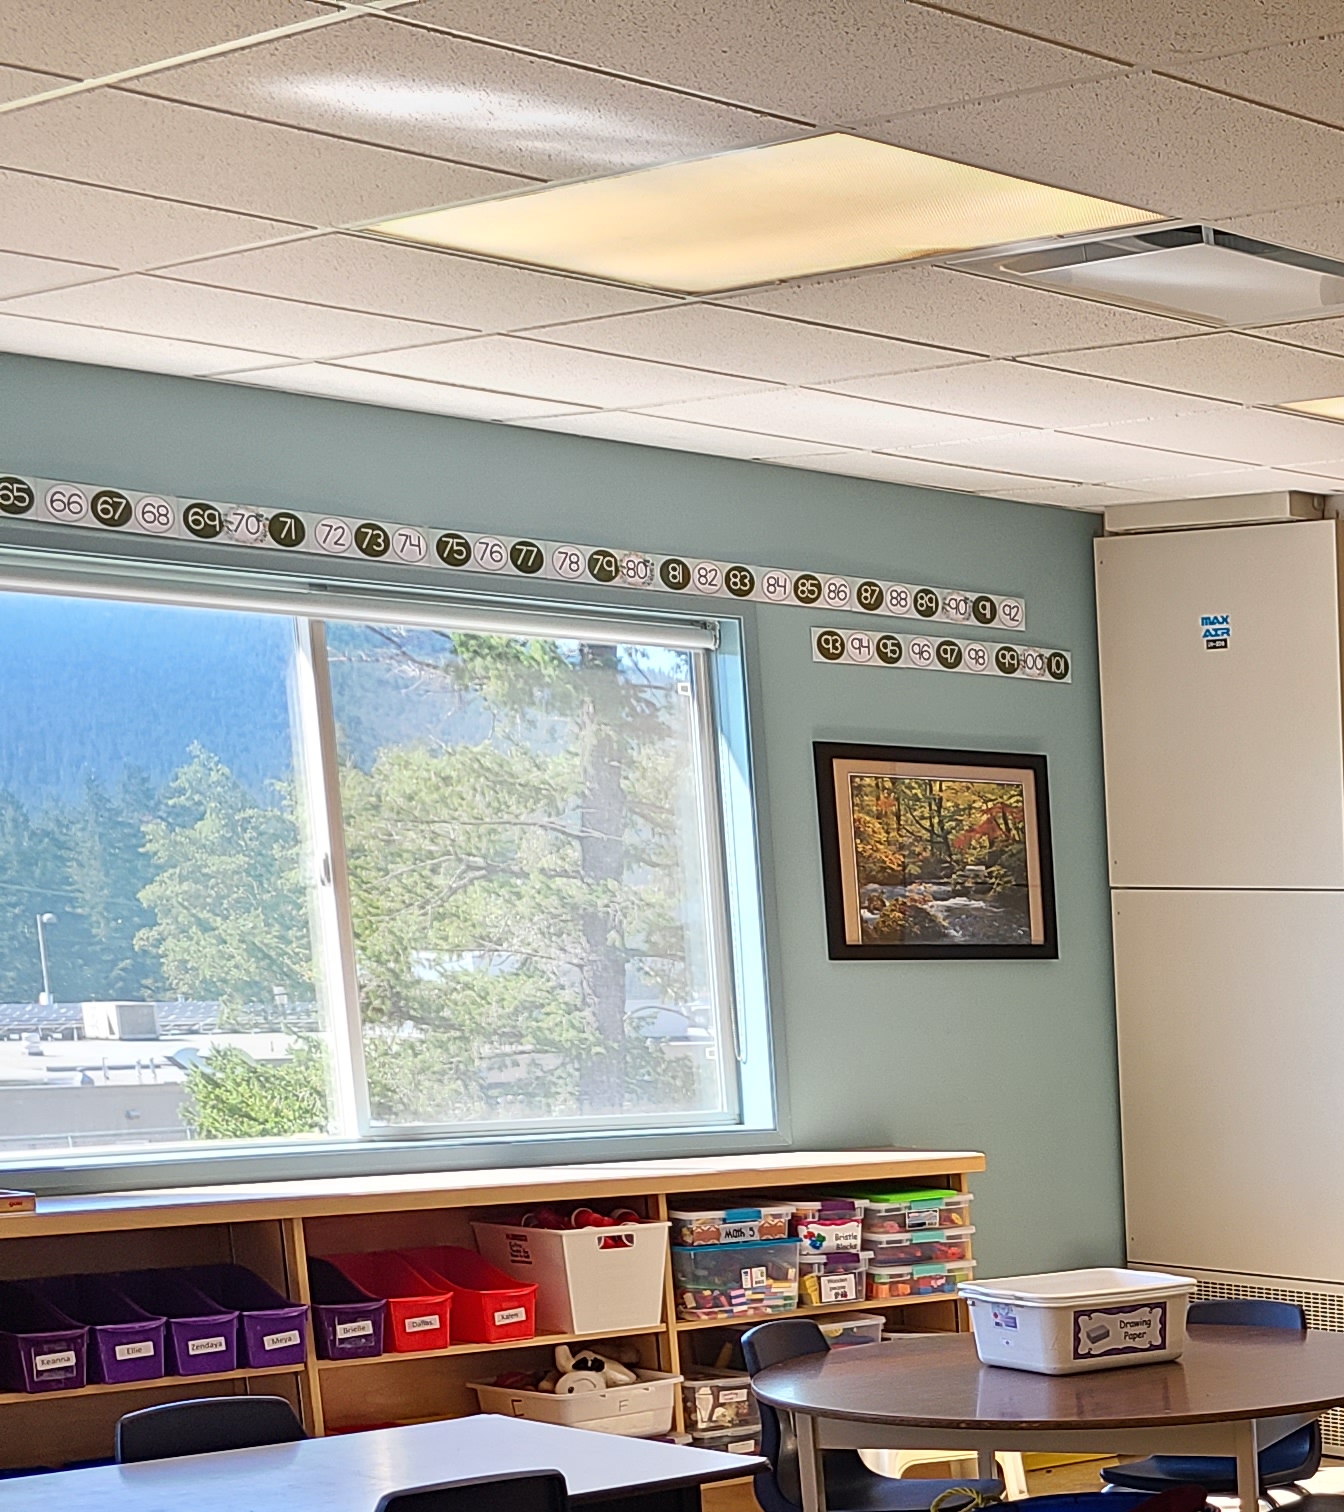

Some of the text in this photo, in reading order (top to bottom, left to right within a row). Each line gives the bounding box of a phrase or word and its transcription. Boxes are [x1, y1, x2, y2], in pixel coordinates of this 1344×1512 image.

[0, 482, 1020, 622] 65 66 67 68 69 70 71 72 73 74 75 76 77 78 79 80 81 82 83 84 85 86 87 88 89 90 91 92
[1201, 615, 1229, 626] MAX
[1203, 628, 1230, 638] AIR
[820, 635, 1065, 674] 93 94 95 96 97 98 99 100 101
[724, 1227, 746, 1239] Math
[834, 1233, 858, 1241] Bristle
[836, 1243, 857, 1251] Blocks
[1119, 1318, 1151, 1329] Drawing
[1123, 1331, 1147, 1341] Paper
[191, 1341, 223, 1351] Zendaya
[41, 1356, 71, 1366] Keanna
